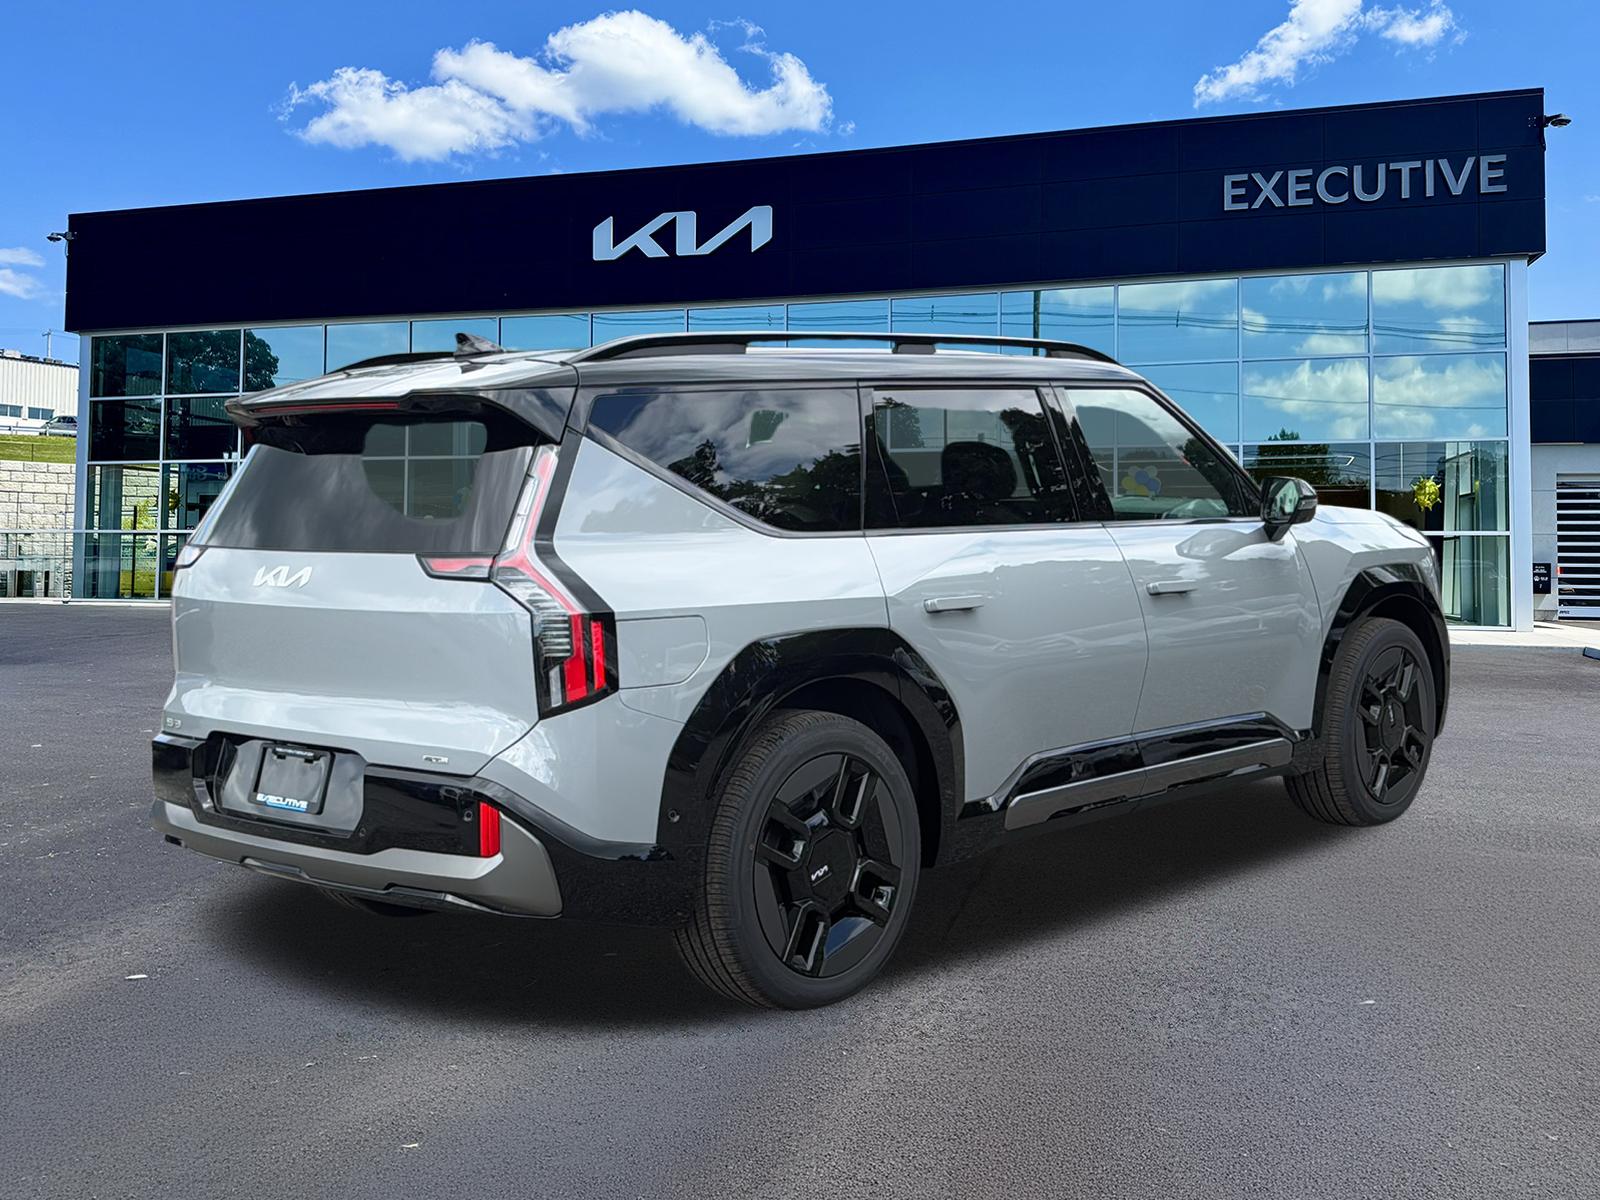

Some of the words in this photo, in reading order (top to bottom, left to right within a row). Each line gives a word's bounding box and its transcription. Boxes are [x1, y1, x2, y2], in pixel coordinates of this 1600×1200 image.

[1223, 154, 1508, 211] EXECUTIVE
[593, 205, 773, 261] KIA
[252, 565, 313, 588] KIA
